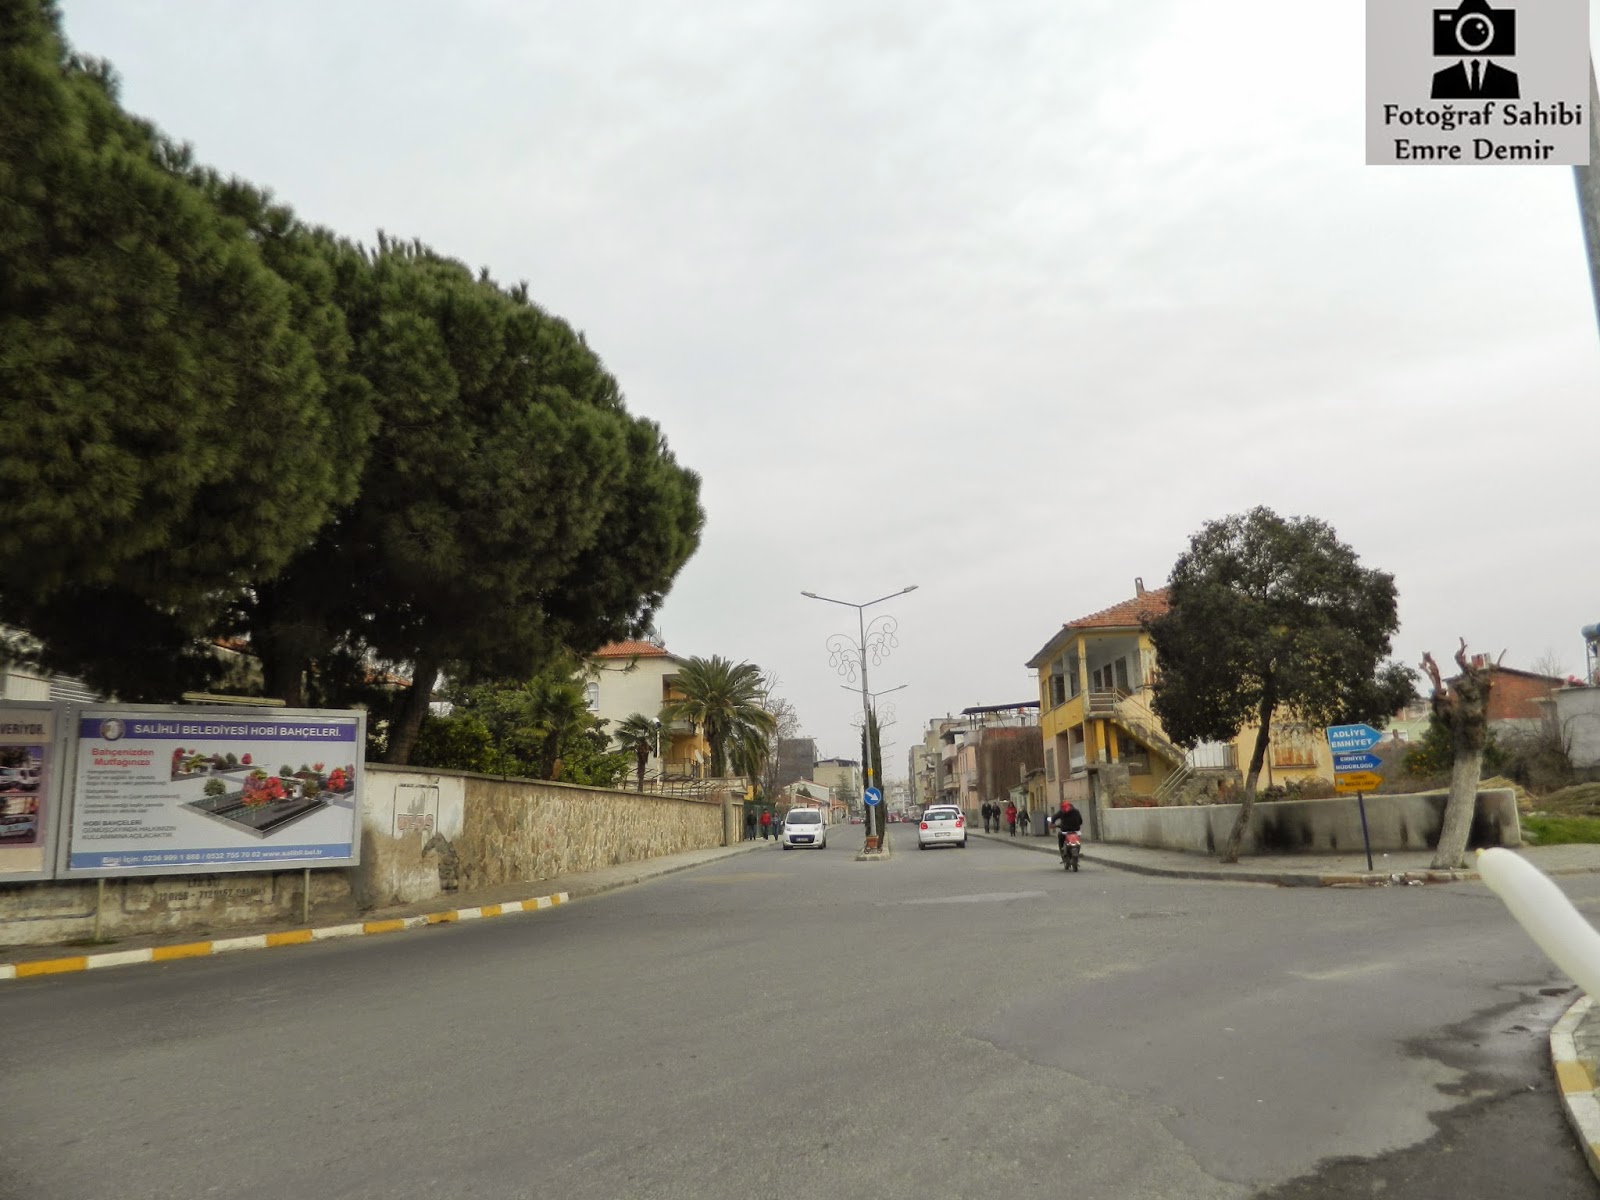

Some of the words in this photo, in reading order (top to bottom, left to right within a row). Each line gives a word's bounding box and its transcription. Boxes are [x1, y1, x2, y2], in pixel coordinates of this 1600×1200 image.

[134, 723, 179, 735] SALİHLİ
[183, 724, 248, 736] BELEDİYESİ
[251, 725, 277, 736] HOBİ
[280, 726, 341, 738] BAHÇELERİ.
[1333, 729, 1366, 738] ADLİYE
[1331, 738, 1372, 748] EMNİYET
